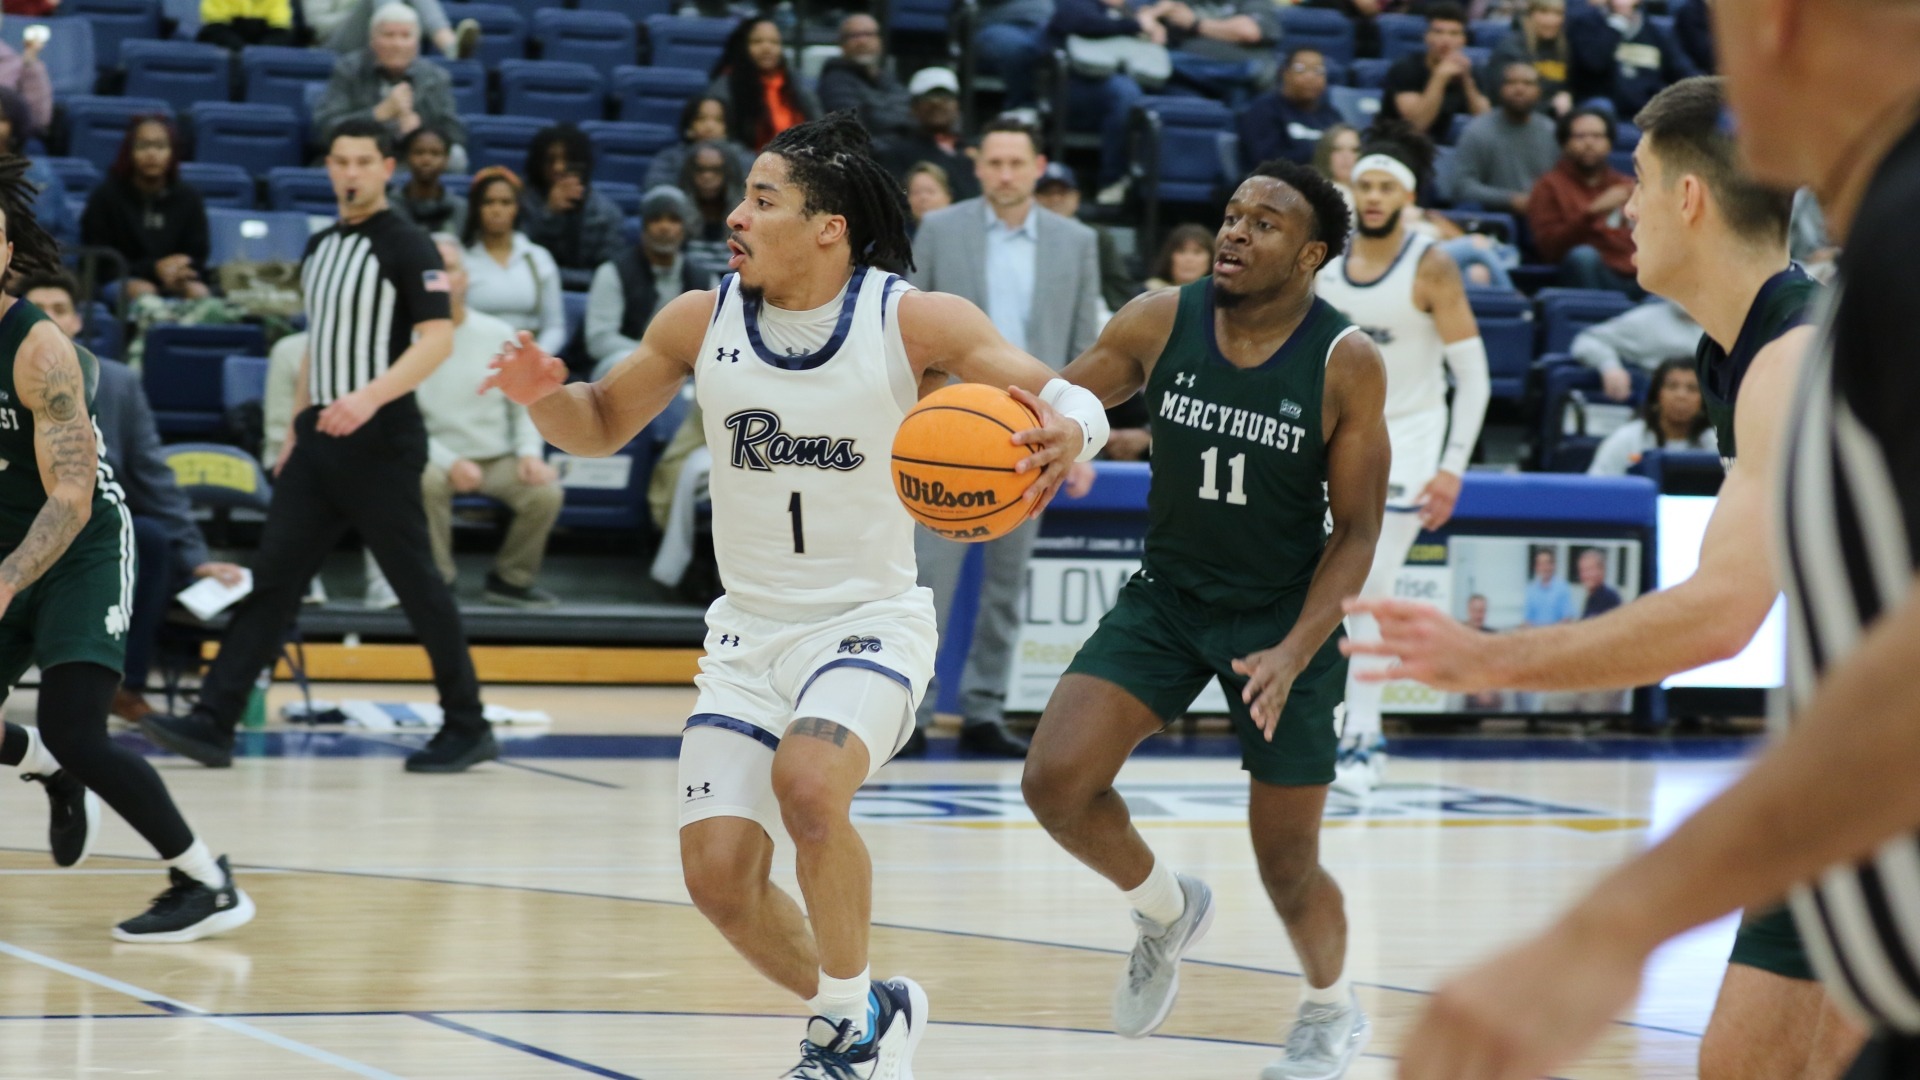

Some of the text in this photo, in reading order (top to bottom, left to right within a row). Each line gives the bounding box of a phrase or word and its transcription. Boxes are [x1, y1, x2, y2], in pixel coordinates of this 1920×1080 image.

[0, 407, 19, 431] ST
[725, 409, 865, 472] Rams
[1159, 390, 1306, 454] MERCYHURST
[898, 470, 996, 508] Wilson
[1198, 446, 1247, 505] 11
[788, 491, 804, 554] 1
